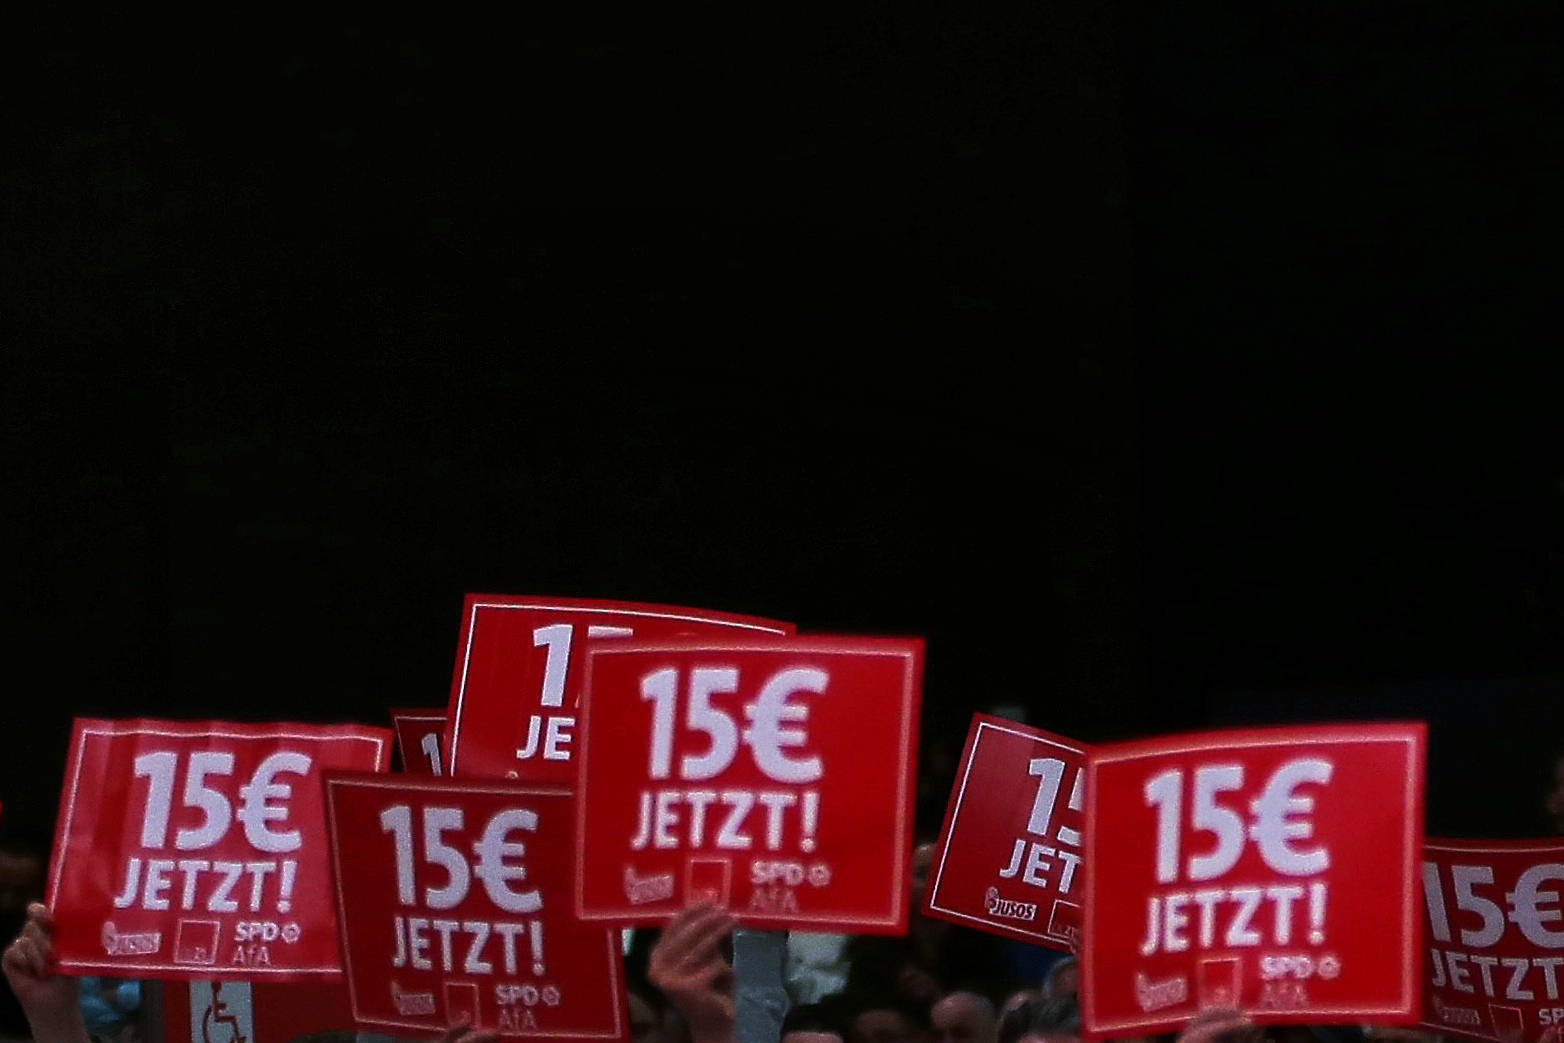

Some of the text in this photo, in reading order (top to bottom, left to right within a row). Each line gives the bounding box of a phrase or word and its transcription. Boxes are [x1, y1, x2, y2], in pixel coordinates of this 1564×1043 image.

[532, 624, 634, 709] 1
[640, 664, 832, 783] 15€
[133, 751, 312, 853] 15€
[629, 790, 821, 854] JETZT!
[1142, 754, 1335, 884] 15€
[113, 858, 298, 914] JETZT!
[379, 804, 544, 914] 15€
[235, 920, 280, 942] SPD
[992, 899, 1037, 921] JUSOS
[1138, 881, 1330, 958] JETZT!
[232, 944, 273, 965] AfA
[392, 915, 546, 977] JETZT!
[495, 983, 539, 1006] SPD
